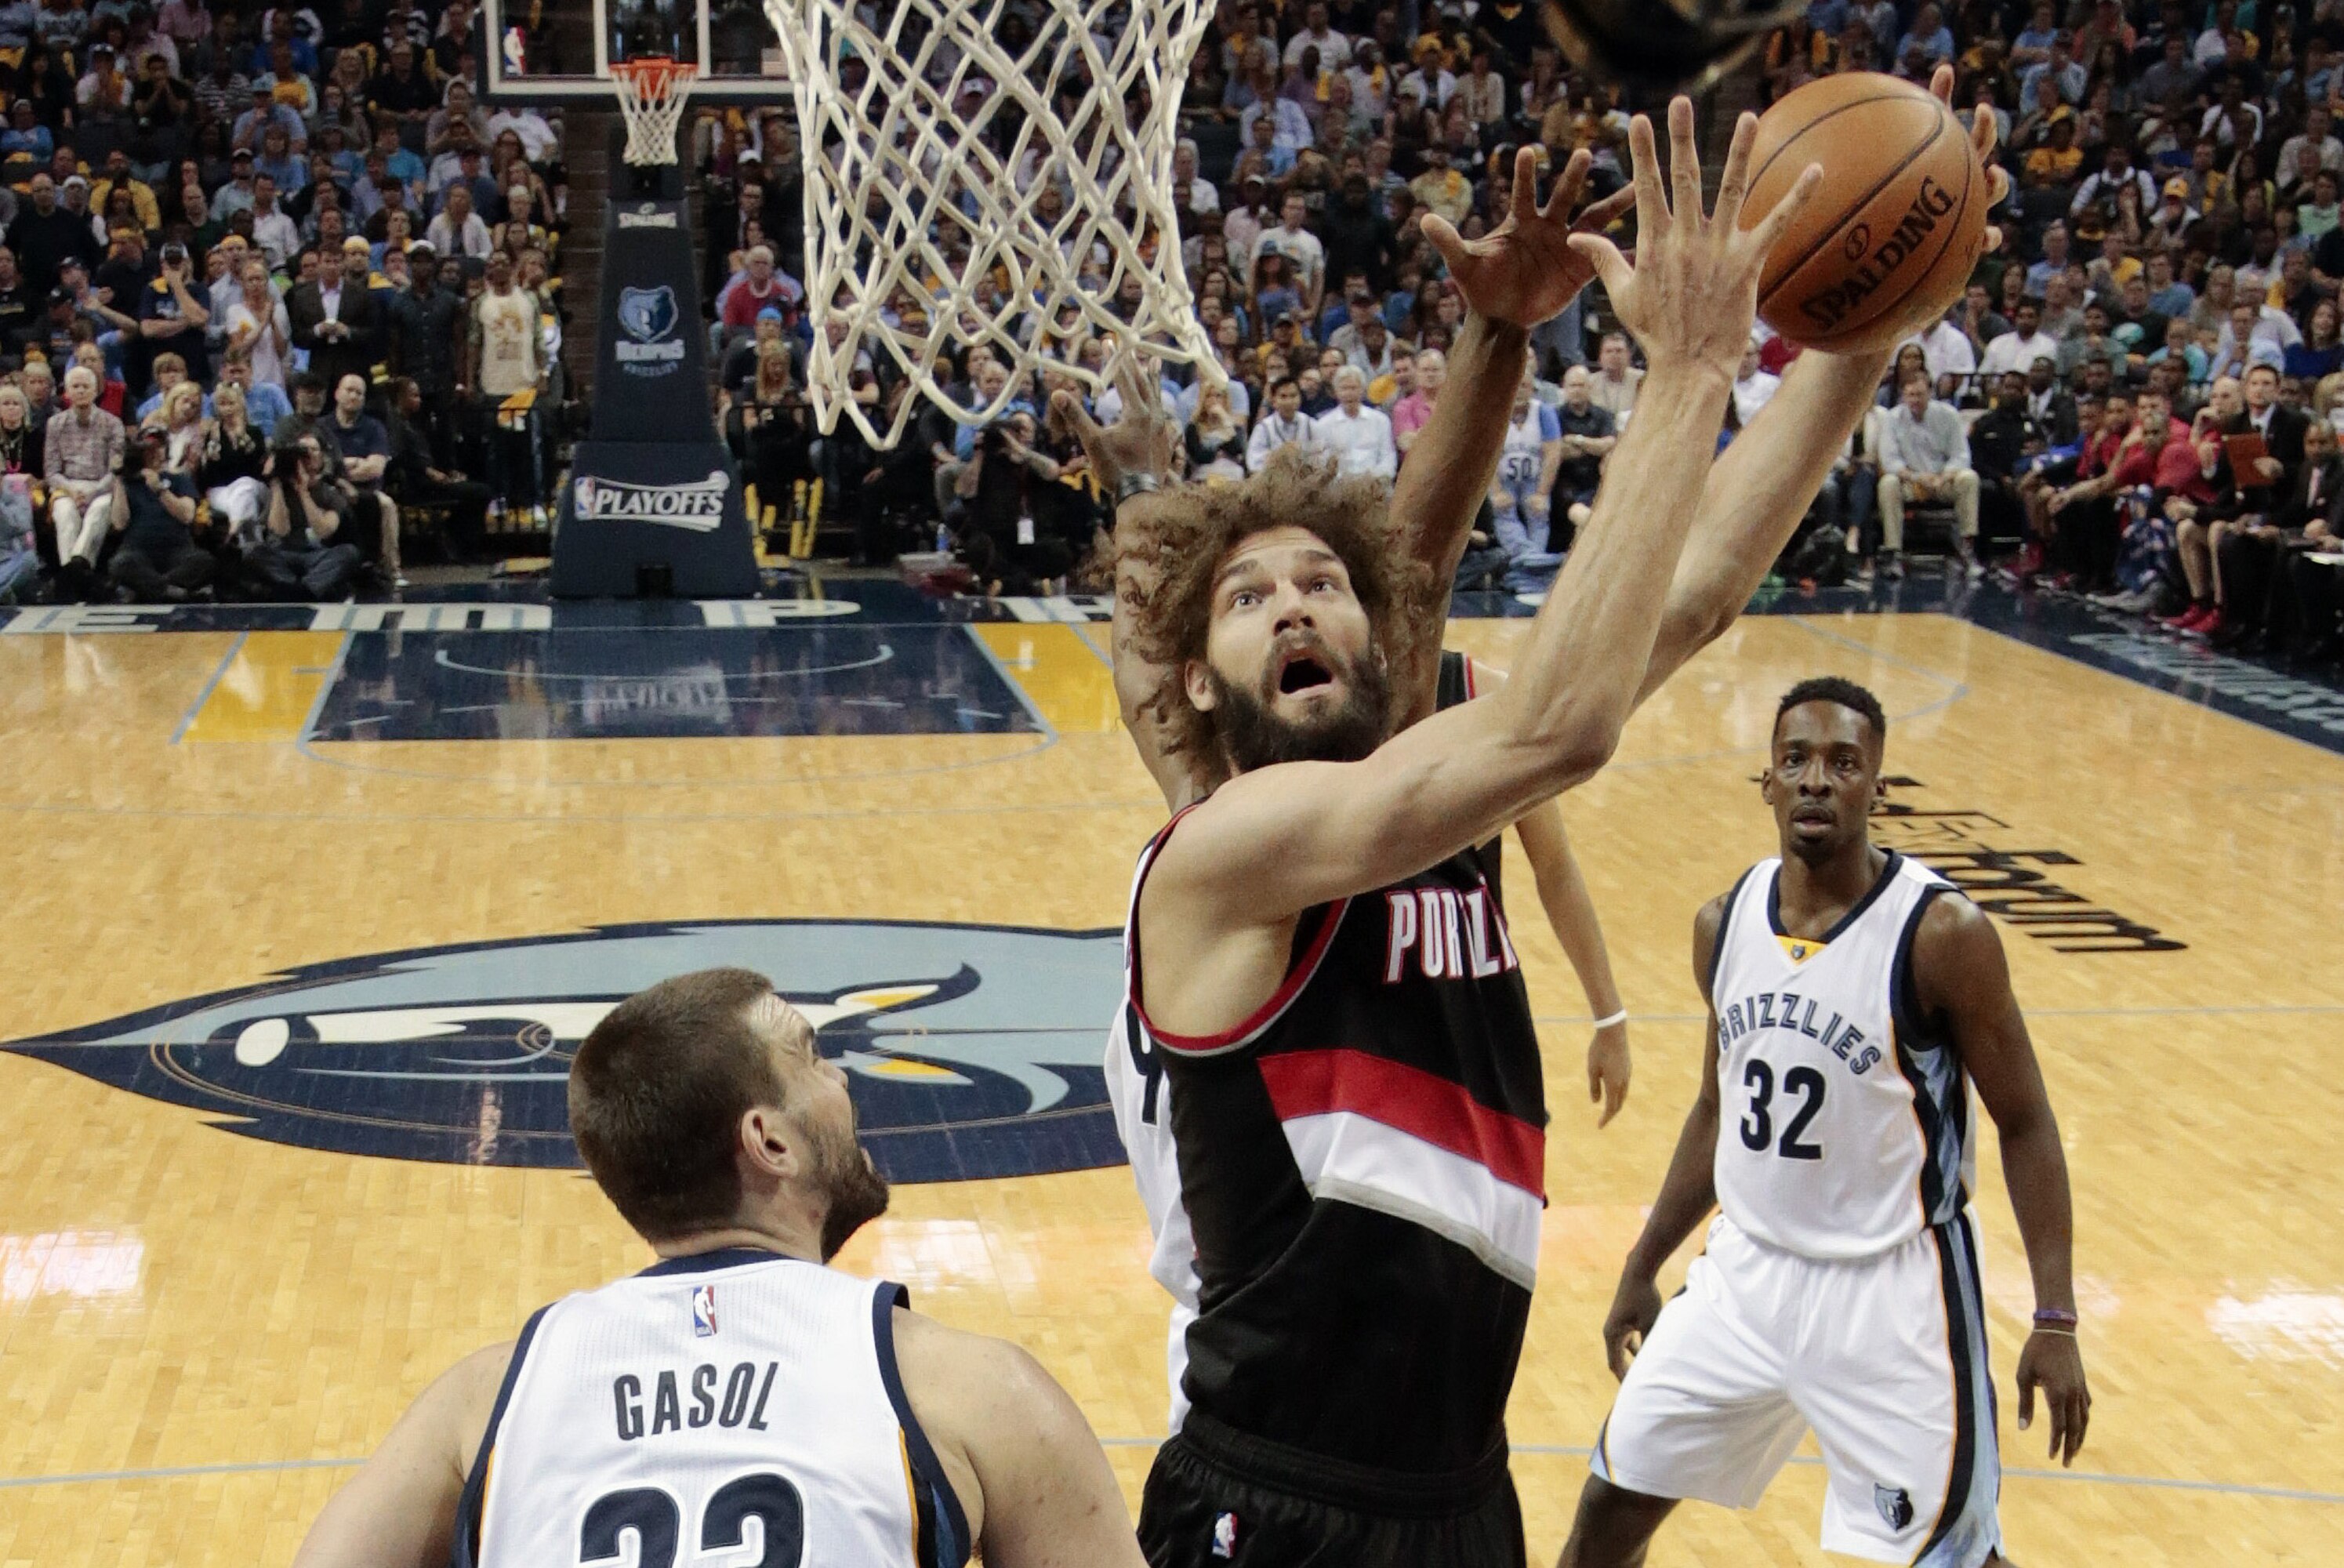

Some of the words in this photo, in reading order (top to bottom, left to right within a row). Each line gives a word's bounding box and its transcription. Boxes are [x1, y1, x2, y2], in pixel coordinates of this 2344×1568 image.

[1800, 174, 1958, 331] SPALDING
[595, 488, 724, 516] PLAYOFFS
[1507, 457, 1531, 480] 50
[1740, 1058, 1827, 1160] 32
[613, 1361, 780, 1441] GASOL
